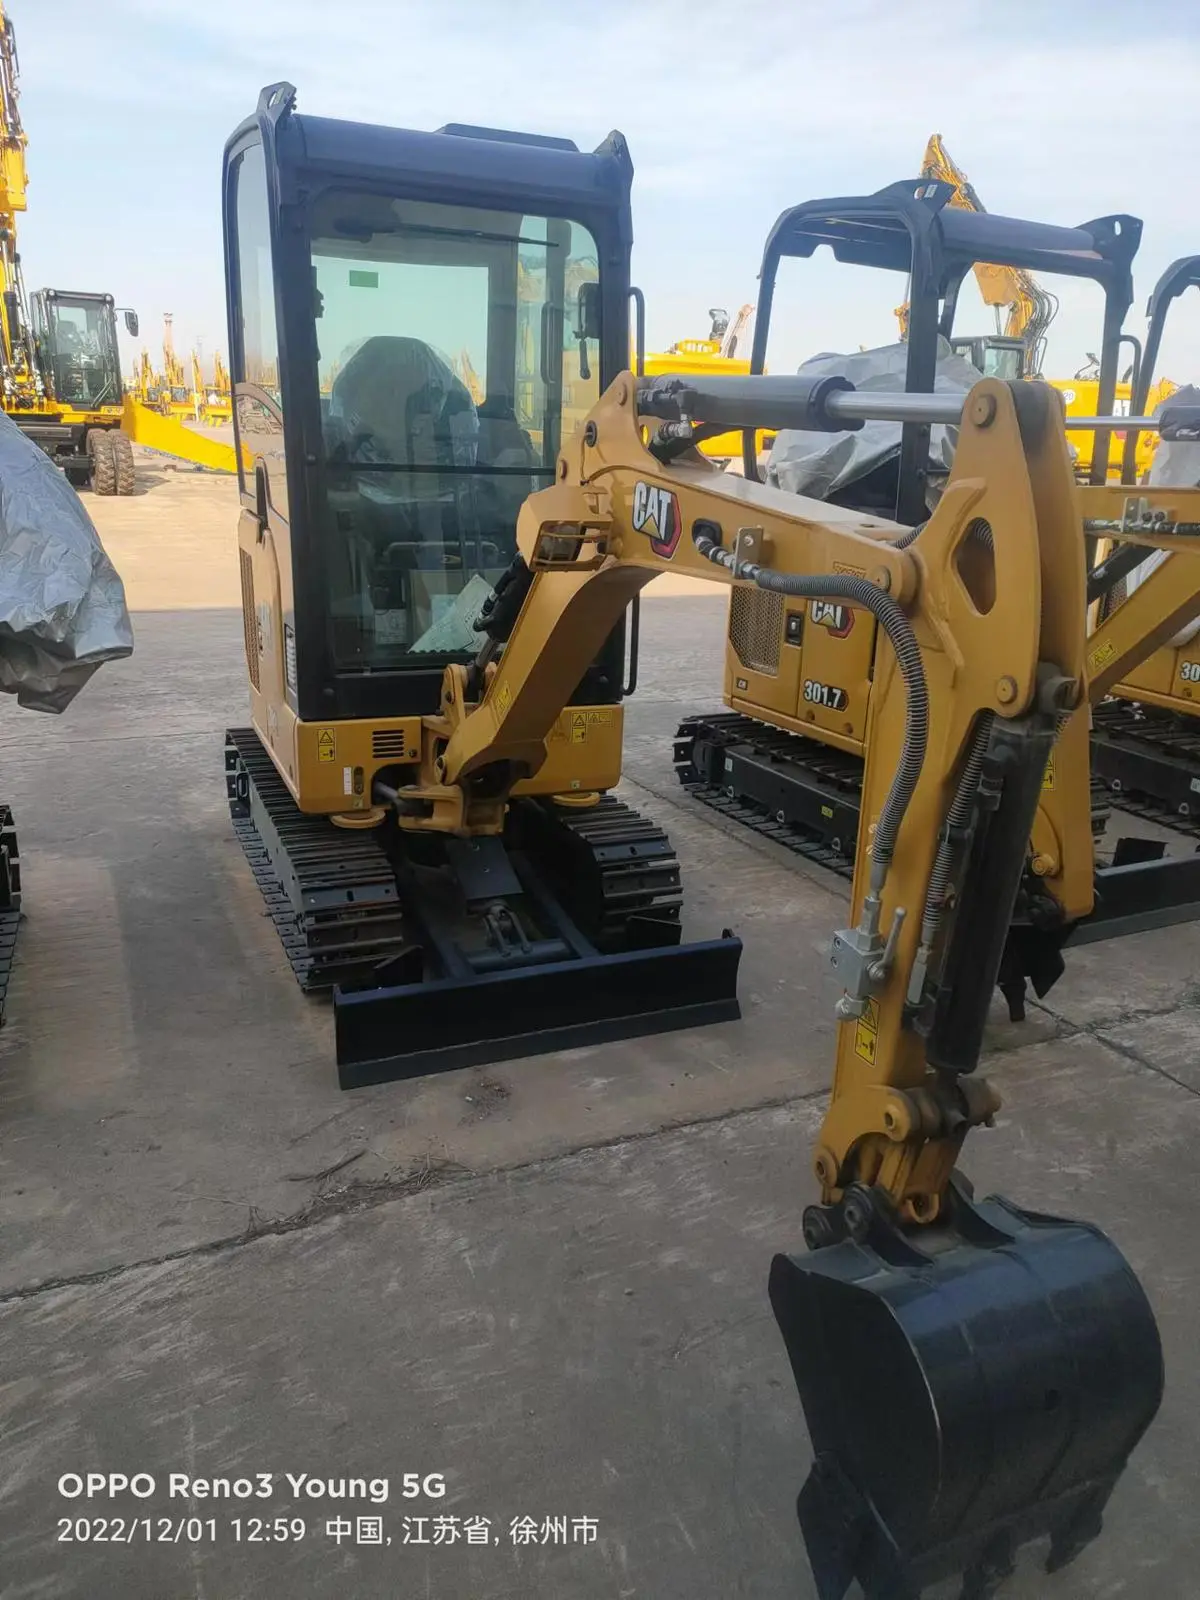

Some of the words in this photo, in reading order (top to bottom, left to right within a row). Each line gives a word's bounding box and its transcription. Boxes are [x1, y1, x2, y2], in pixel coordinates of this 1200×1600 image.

[1112, 400, 1130, 417] AT
[633, 481, 672, 541] CAT
[812, 600, 843, 629] CAT
[1181, 661, 1200, 682] 30
[804, 680, 842, 708] 301.7
